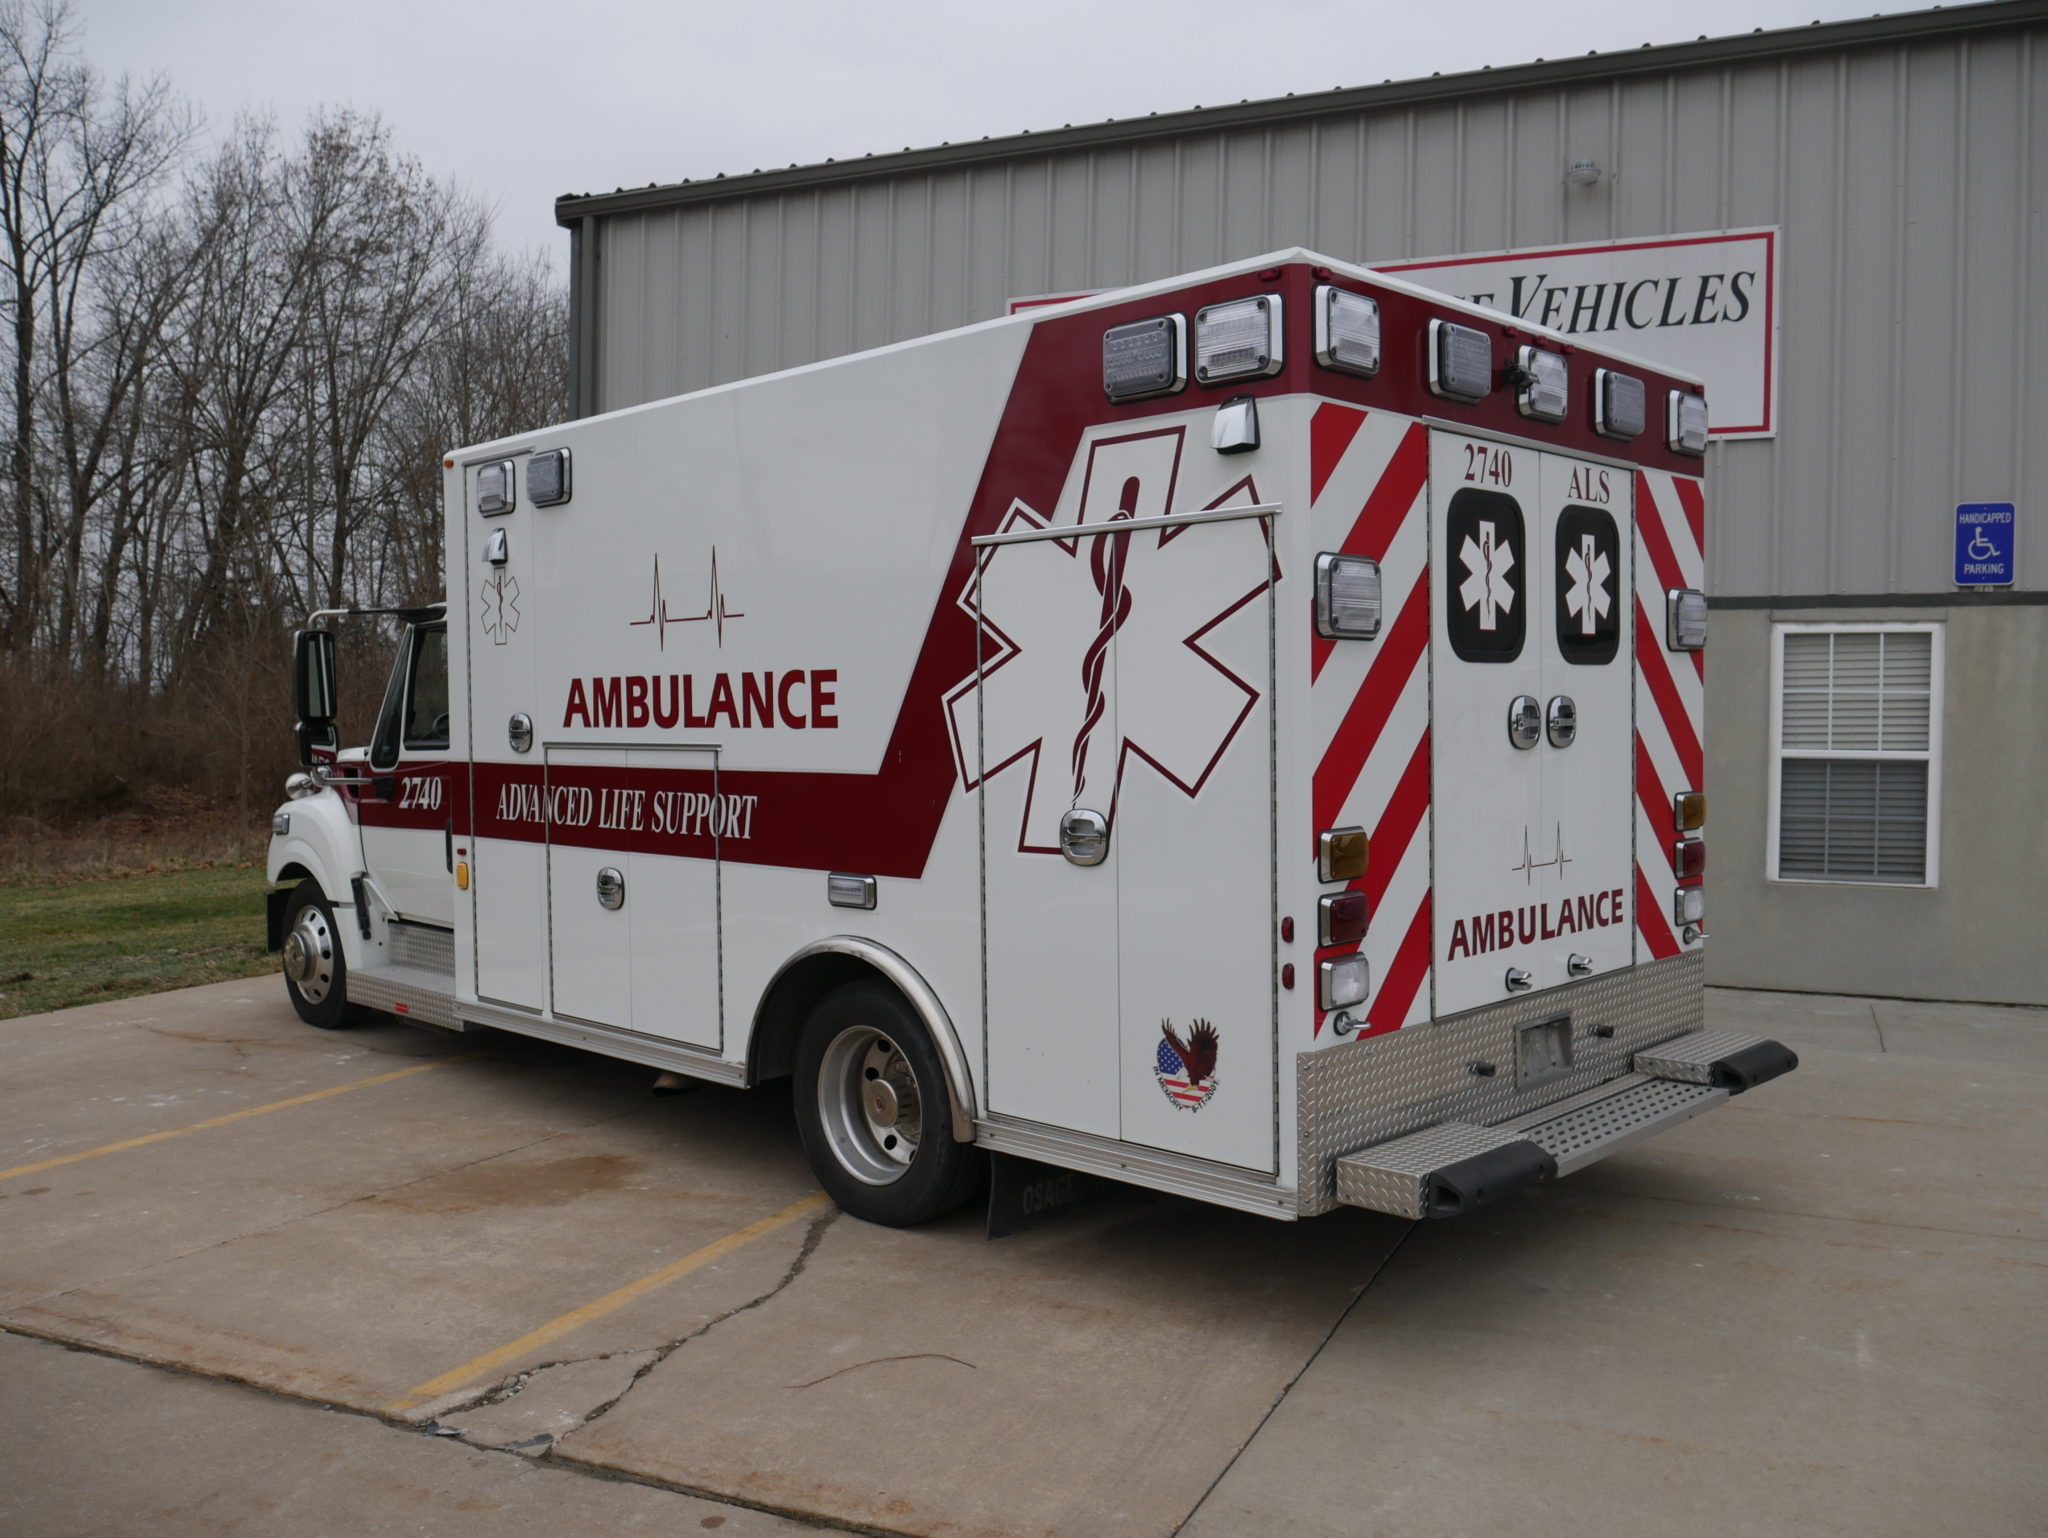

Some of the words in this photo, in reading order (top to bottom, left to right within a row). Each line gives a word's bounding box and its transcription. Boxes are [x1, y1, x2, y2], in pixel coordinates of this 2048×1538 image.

[1510, 271, 1756, 334] VEHICLES
[1463, 443, 1513, 488] 2740
[1567, 465, 1611, 505] ALS
[1959, 511, 2012, 524] HANDICAPPED
[1963, 562, 2005, 575] PARKING
[562, 669, 839, 730] AMBULANCE
[398, 776, 442, 811] 2740
[496, 783, 593, 827] ADVANCED
[598, 788, 646, 831] LIFE
[651, 790, 758, 839] SUPPORT
[1447, 887, 1625, 962] AMBULANCE
[1157, 1077, 1184, 1112] MEMORY
